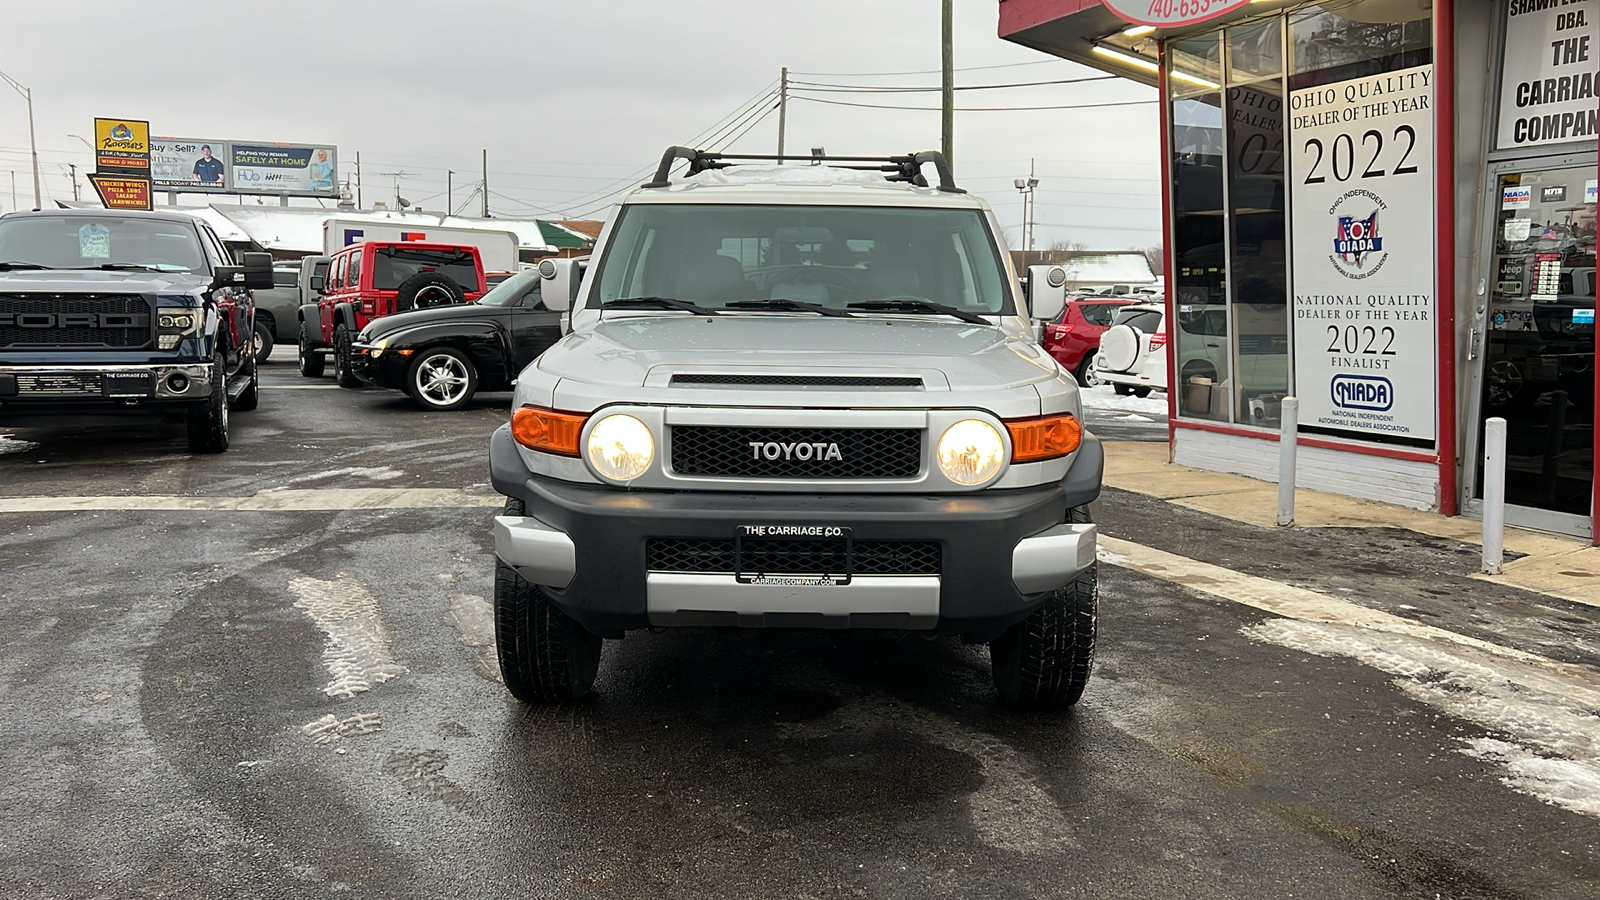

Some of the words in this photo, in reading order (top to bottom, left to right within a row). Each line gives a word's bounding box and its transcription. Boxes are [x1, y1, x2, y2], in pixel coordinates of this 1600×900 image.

[1147, 0, 1227, 18] 740-653-
[1556, 10, 1588, 31] DBA.
[1552, 35, 1590, 66] THE
[1291, 88, 1336, 110] OHIO
[1345, 70, 1431, 103] QUALITY
[1233, 109, 1276, 131] EALER
[1294, 110, 1340, 130] DEALER
[1343, 107, 1359, 122] OF
[1362, 101, 1389, 118] THE
[1392, 95, 1429, 114] YEAR
[102, 138, 144, 150] Roosters
[175, 144, 196, 152] Sell?
[235, 156, 266, 164] SAFELY
[281, 158, 306, 166] HOME
[1304, 124, 1418, 185] 2022
[1329, 197, 1343, 215] OHIO
[1343, 189, 1388, 211] INDEPENDENT
[1504, 190, 1529, 198] NIADA
[1340, 239, 1374, 252] OIADA
[1328, 254, 1349, 278] AUTOMOBILE
[1367, 252, 1389, 277] ASSOCIATION
[1501, 264, 1522, 275] Jeep
[1296, 295, 1361, 306] NATIONAL
[1367, 295, 1430, 307] QUALITY
[1298, 309, 1341, 319] DEALER
[1346, 309, 1361, 320] OF
[1366, 310, 1389, 320] THE
[1395, 310, 1428, 321] YEAR
[1326, 324, 1397, 356] 2022
[1331, 356, 1390, 370] FINALIST
[1336, 382, 1387, 404] NIADA
[1332, 410, 1357, 419] NATIONAL
[1358, 412, 1393, 422] INDEPENDENT
[1318, 417, 1349, 427] AUTOMOBILE
[1350, 420, 1372, 429] DEALERS
[1373, 422, 1410, 433] ASSOCIATION
[749, 442, 843, 461] TOYOTA
[744, 525, 766, 536] THE
[768, 526, 823, 536] CARRIAGE
[825, 526, 843, 537] CO.
[750, 578, 837, 586] CARRIAGECOMPANY.COM
